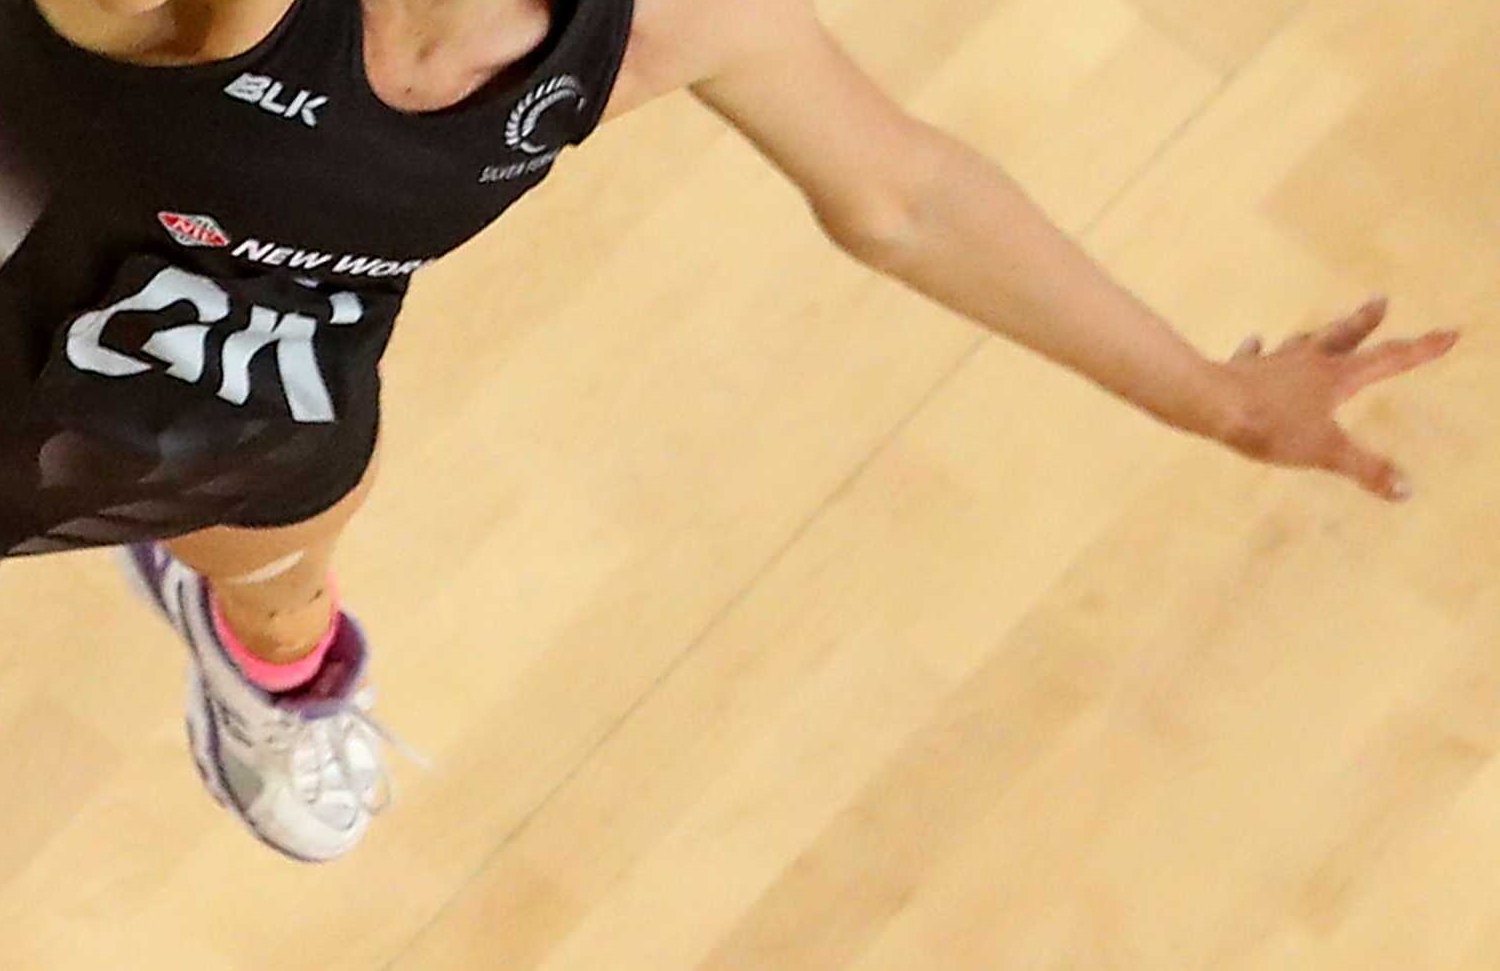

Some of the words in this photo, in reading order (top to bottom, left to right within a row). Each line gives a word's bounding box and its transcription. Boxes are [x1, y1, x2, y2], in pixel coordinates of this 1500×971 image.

[223, 73, 331, 128] BLK
[230, 237, 333, 269] NEW
[332, 253, 437, 278] WOR
